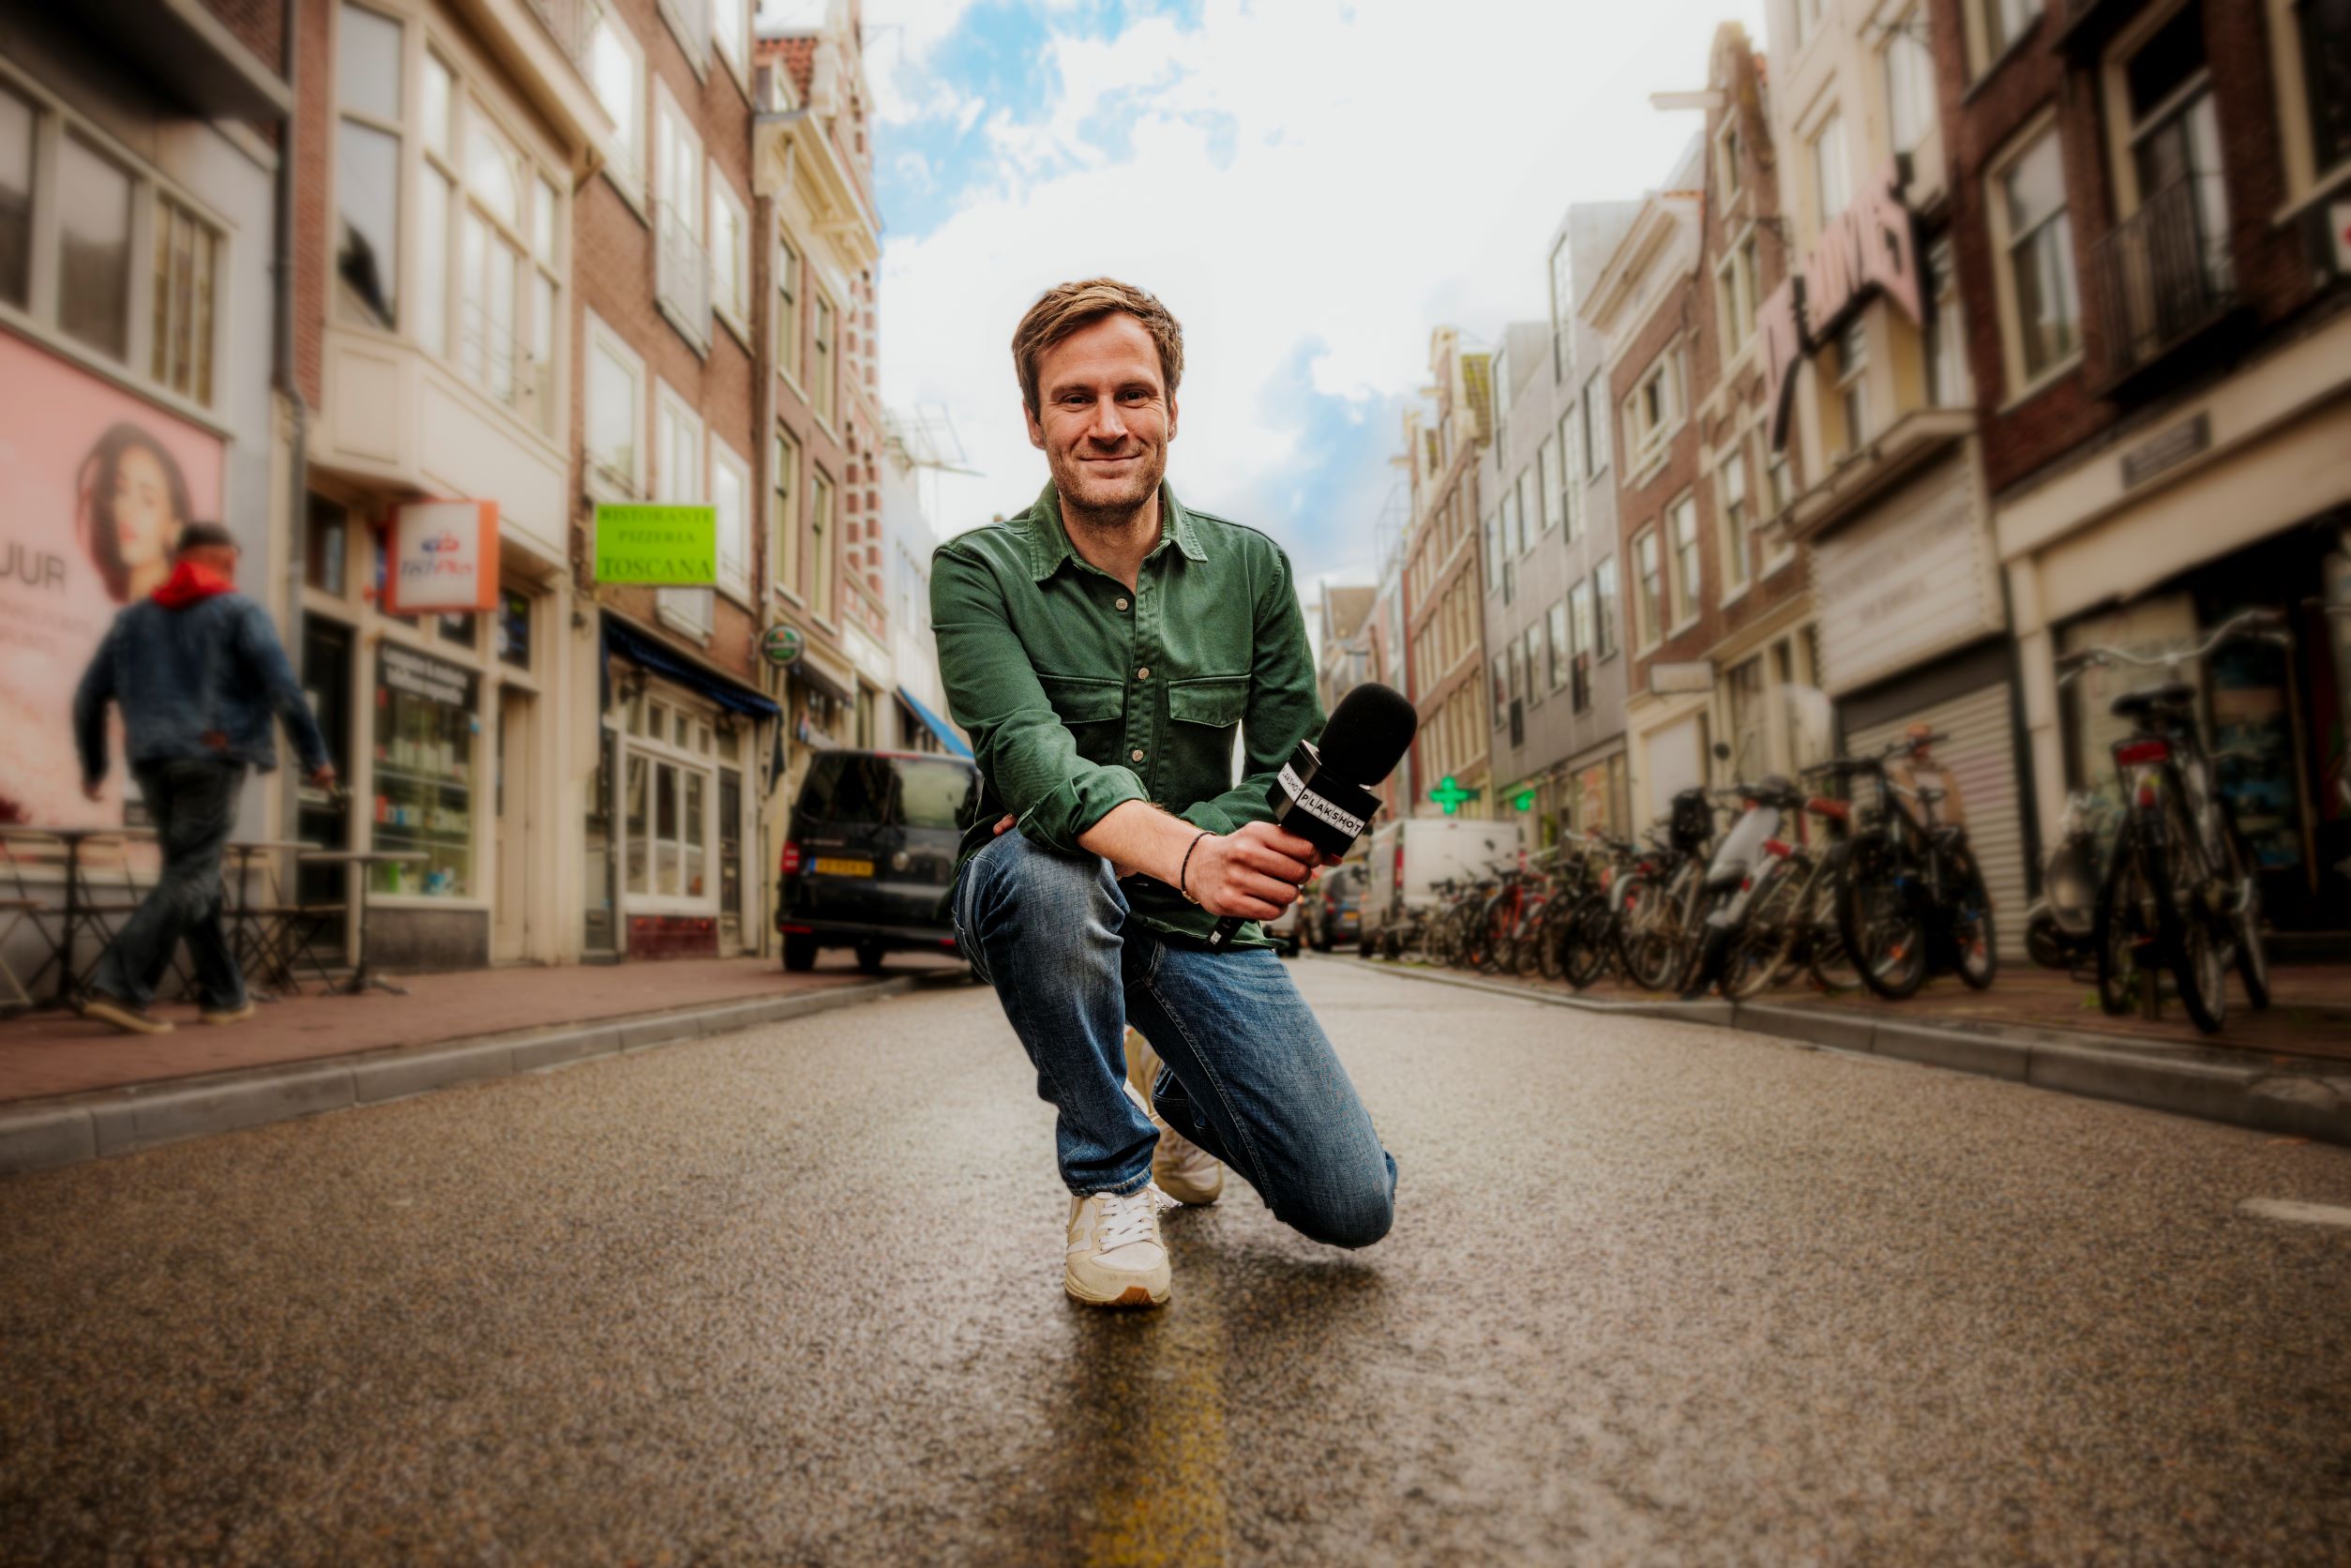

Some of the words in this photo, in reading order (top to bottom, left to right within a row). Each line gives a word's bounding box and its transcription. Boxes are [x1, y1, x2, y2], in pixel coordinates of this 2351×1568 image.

[601, 508, 711, 523] RISTORANTE
[618, 530, 696, 544] PIZZERIA
[600, 555, 713, 580] TOSCANA
[1301, 793, 1362, 833] PLAKSHOT
